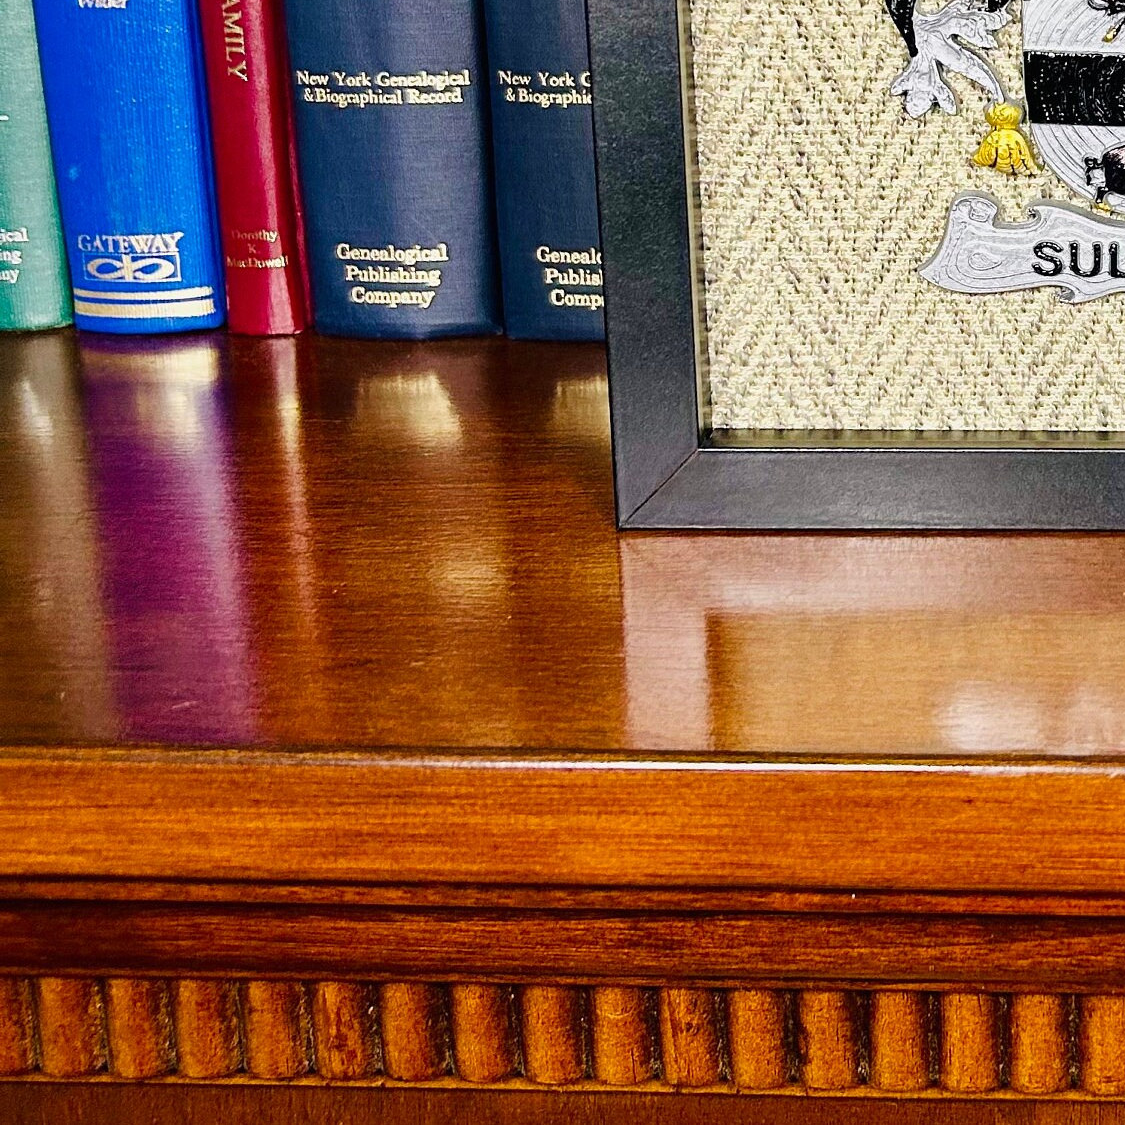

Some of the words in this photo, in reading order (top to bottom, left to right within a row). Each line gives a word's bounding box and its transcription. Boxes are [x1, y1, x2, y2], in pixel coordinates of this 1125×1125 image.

[296, 70, 330, 86] New
[334, 71, 372, 87] York
[375, 69, 471, 91] Genealogical
[497, 70, 532, 86] New
[537, 71, 576, 87] York
[406, 87, 464, 104] Record
[77, 231, 185, 254] GATEWAY
[231, 229, 278, 243] Dorothy
[226, 255, 289, 269] MacDowell
[336, 242, 450, 266] Genealogical
[345, 264, 442, 287] Publishing
[350, 286, 436, 309] Company
